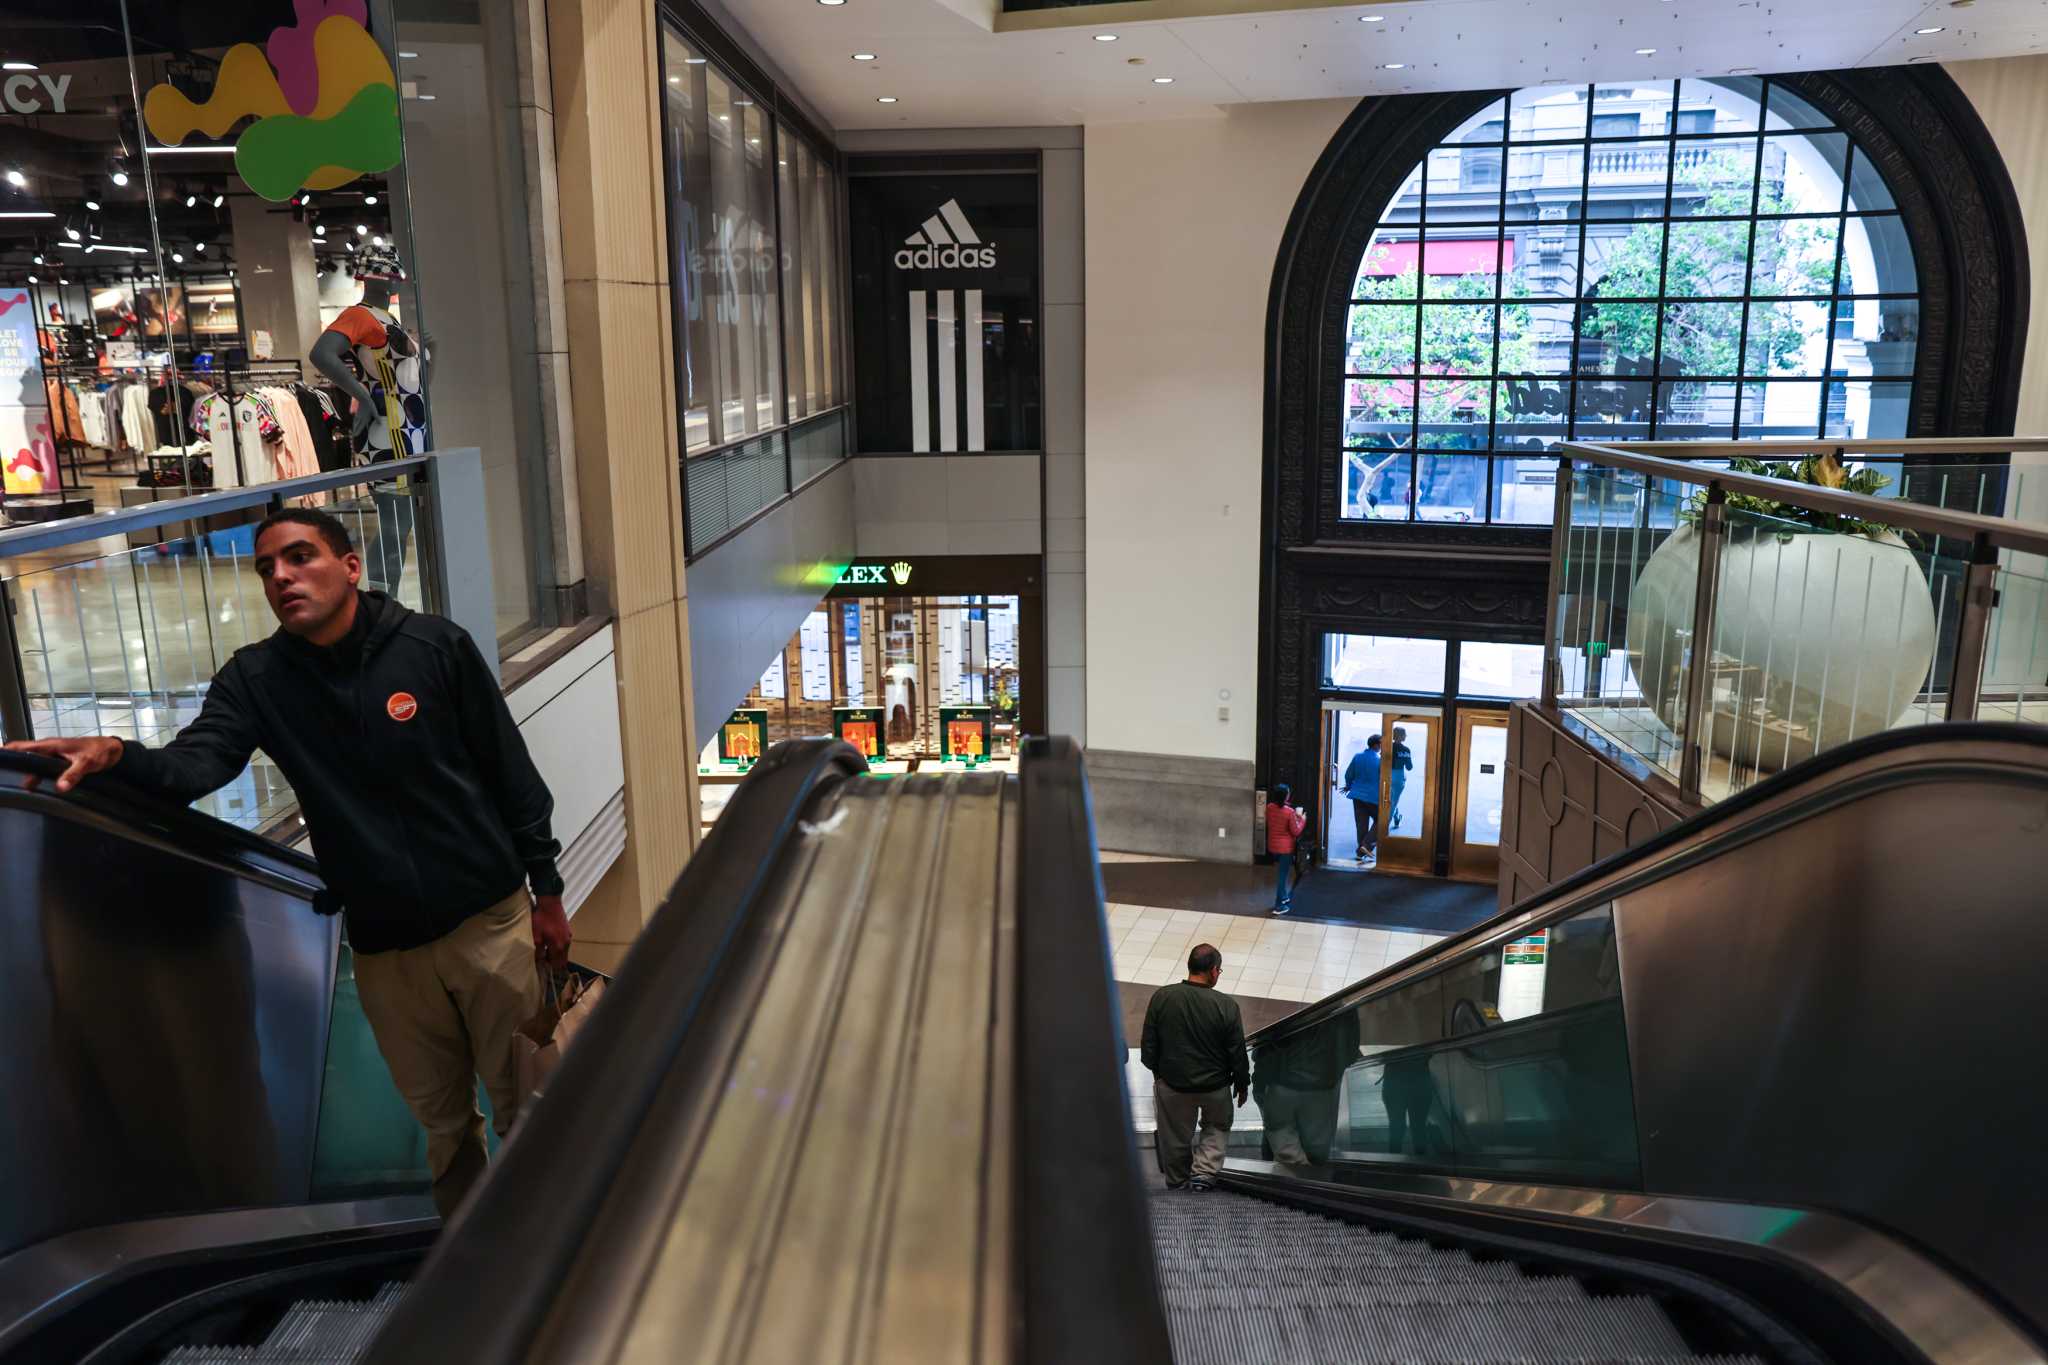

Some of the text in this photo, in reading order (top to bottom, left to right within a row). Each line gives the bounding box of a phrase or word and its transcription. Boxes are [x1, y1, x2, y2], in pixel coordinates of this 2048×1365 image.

[0, 74, 72, 114] CY
[894, 243, 996, 269] adidas
[836, 566, 887, 583] LEX
